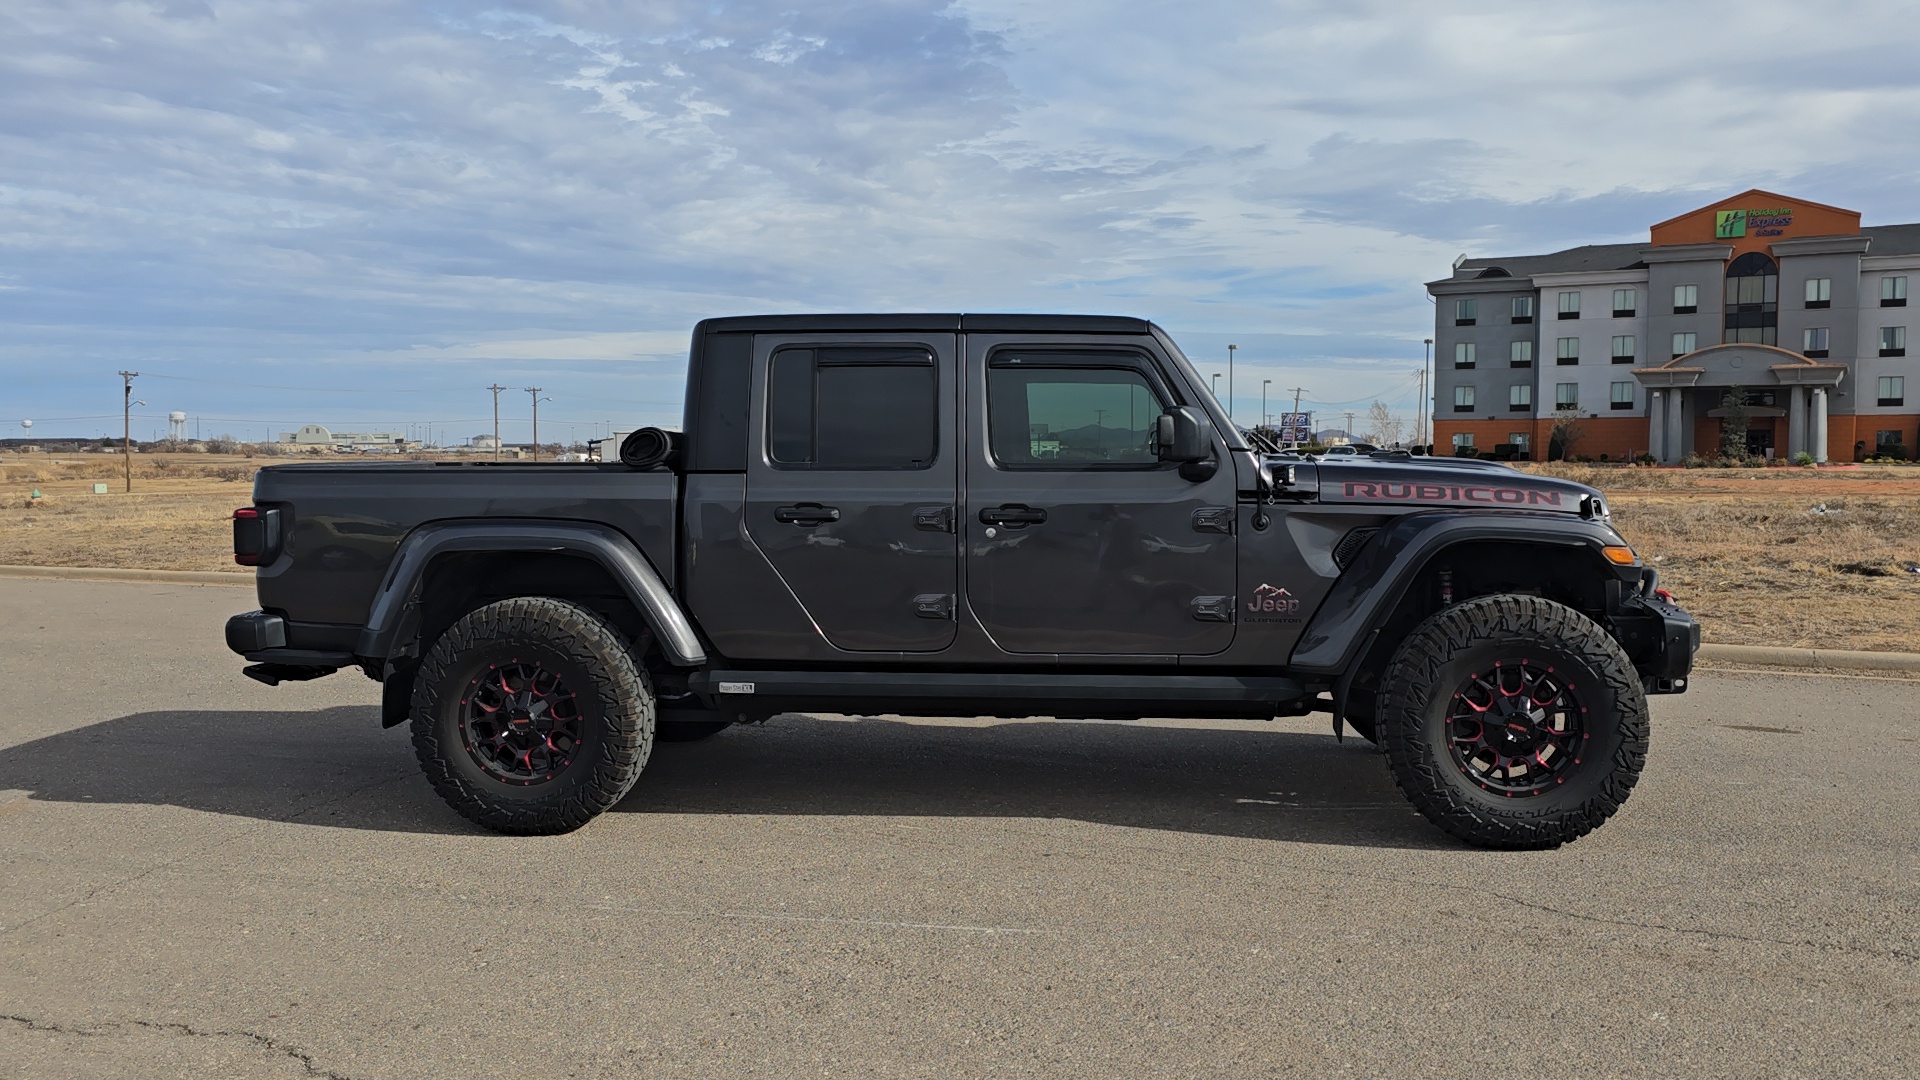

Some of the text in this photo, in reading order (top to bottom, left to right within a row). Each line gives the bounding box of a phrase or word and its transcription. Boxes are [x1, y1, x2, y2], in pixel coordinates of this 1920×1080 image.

[1749, 207, 1793, 217] Holiday Inn
[1749, 216, 1793, 228] Express
[1342, 482, 1562, 506] RUBICON
[1247, 594, 1300, 615] Jeep
